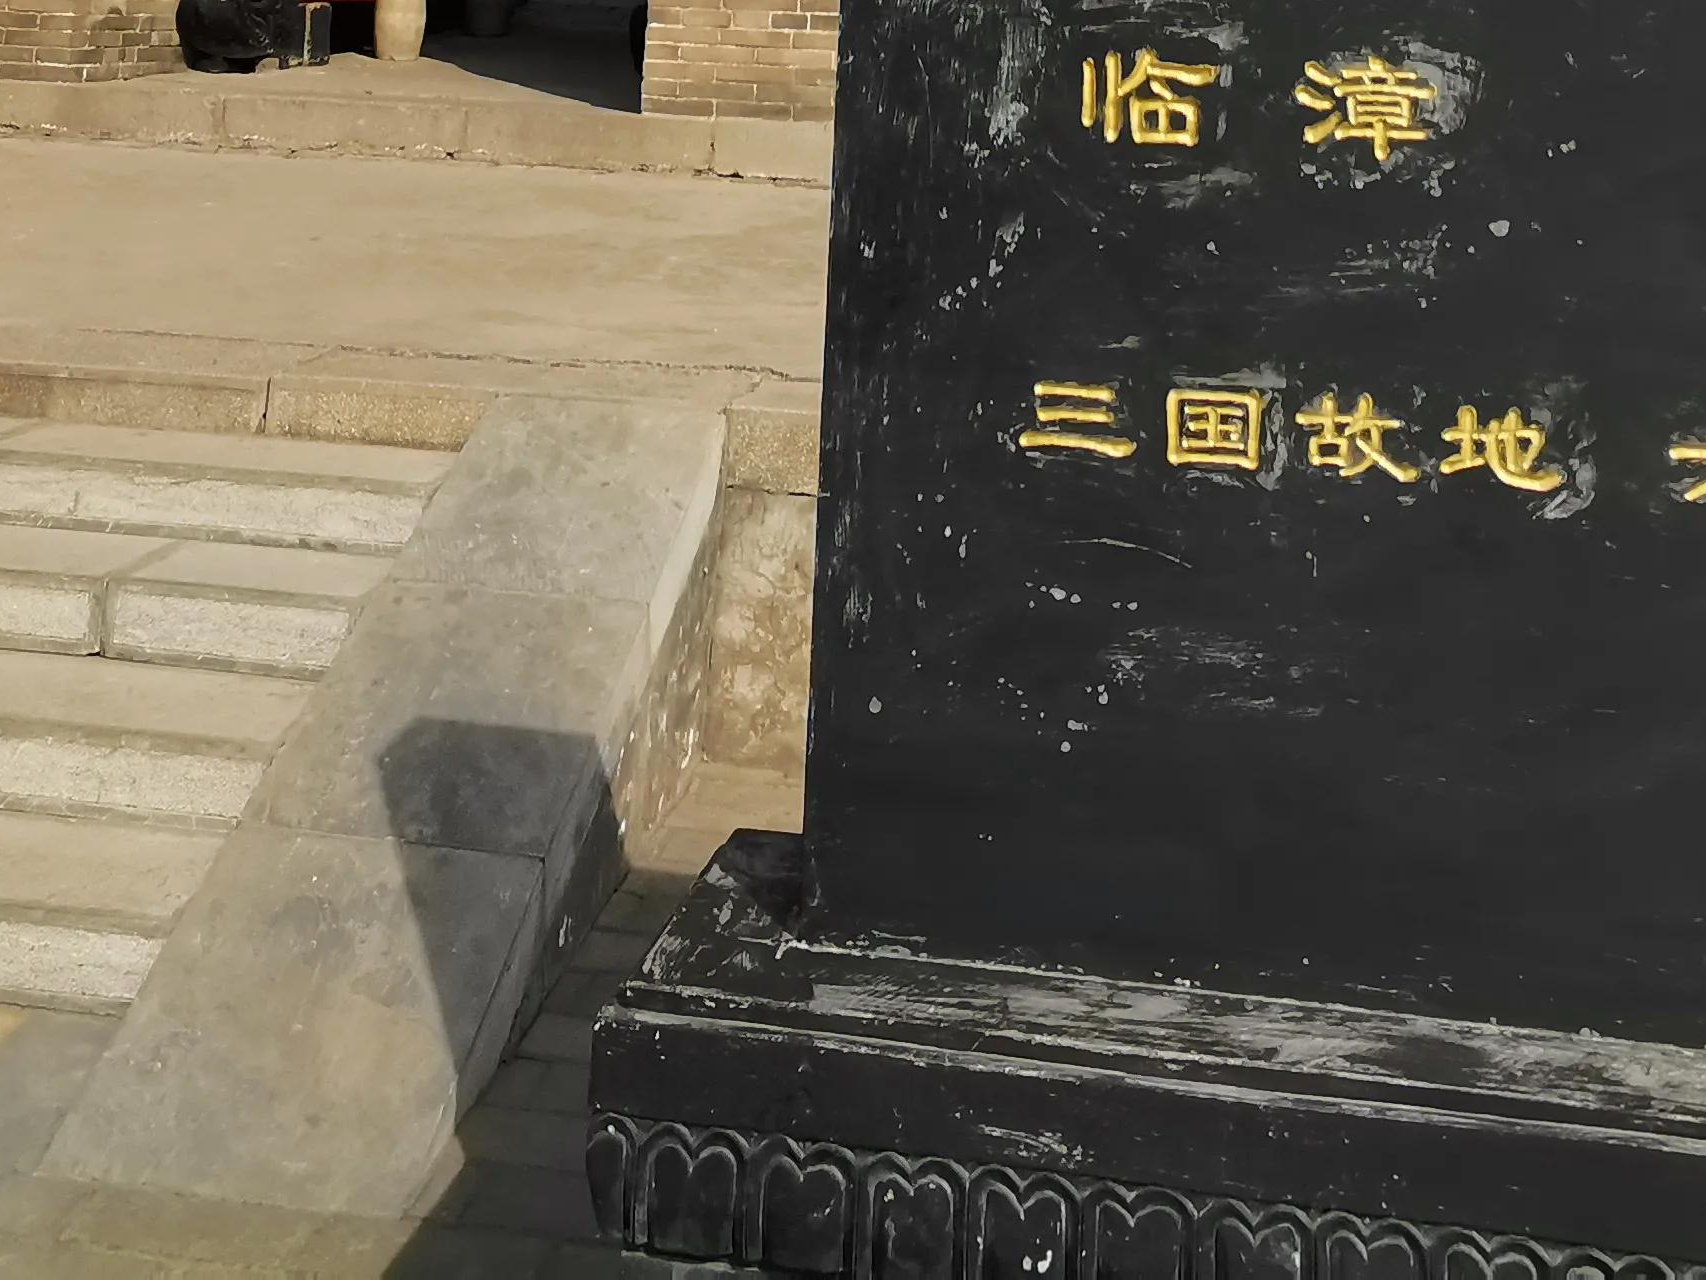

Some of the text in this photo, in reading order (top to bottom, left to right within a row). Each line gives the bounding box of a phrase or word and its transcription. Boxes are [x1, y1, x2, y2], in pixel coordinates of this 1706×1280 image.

[1081, 48, 1437, 161] 临漳
[1018, 379, 1567, 492] 三国故地
